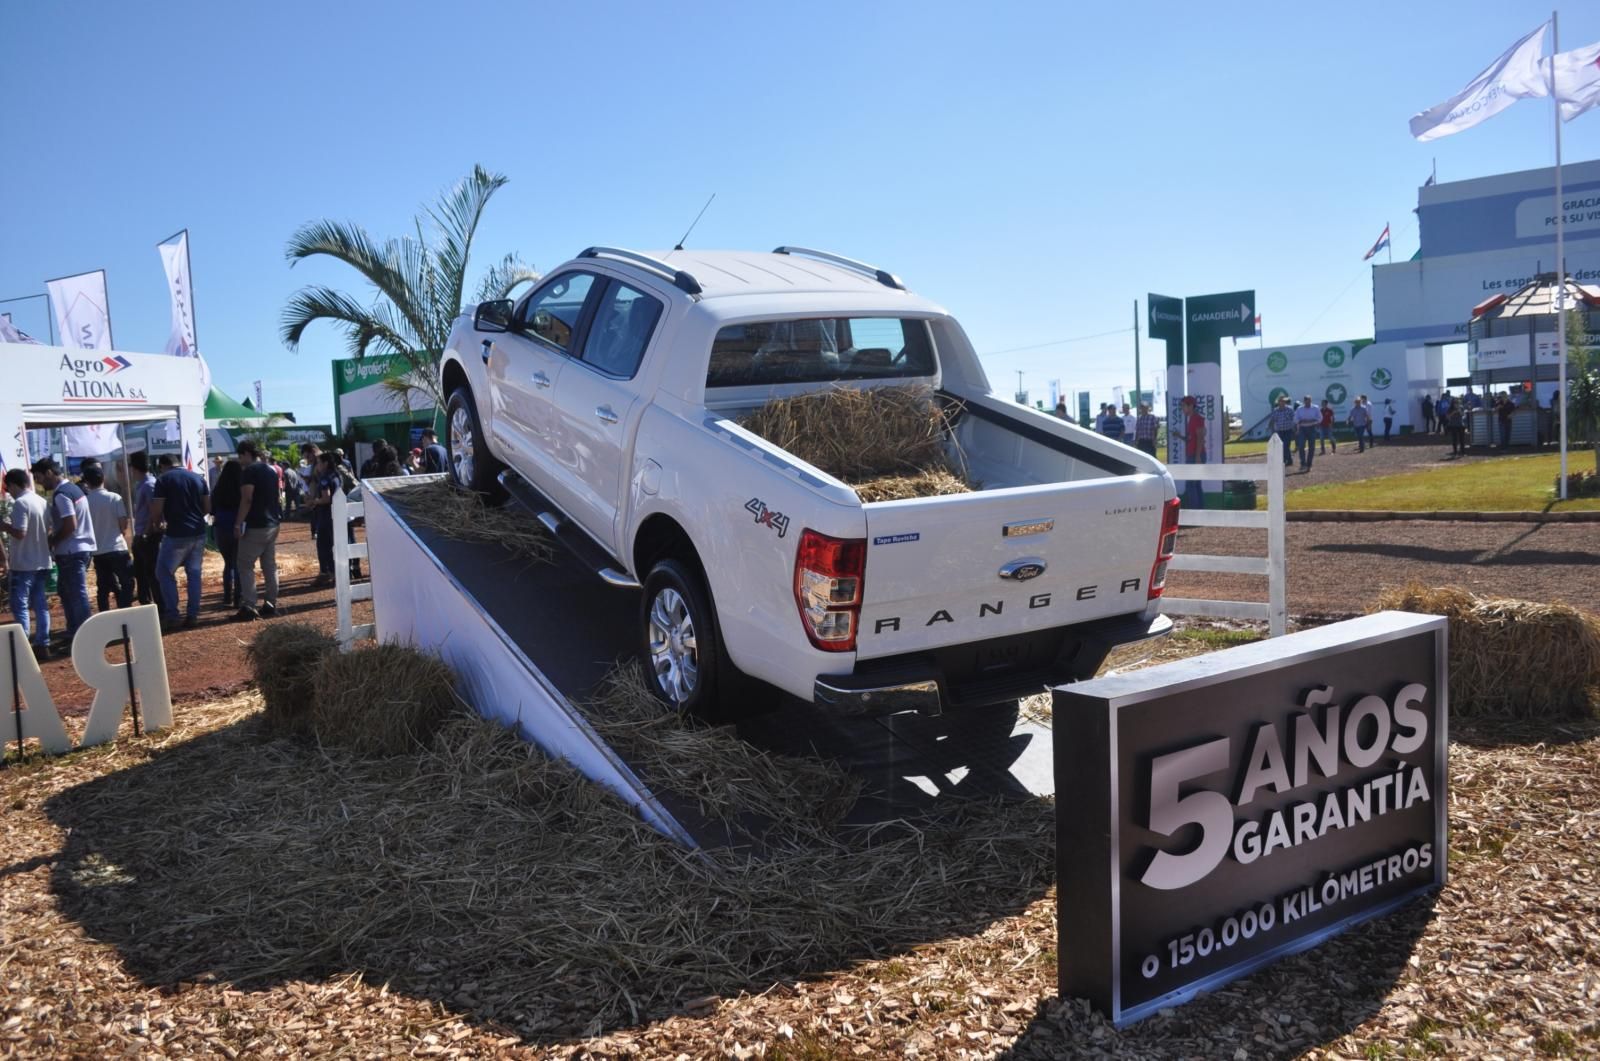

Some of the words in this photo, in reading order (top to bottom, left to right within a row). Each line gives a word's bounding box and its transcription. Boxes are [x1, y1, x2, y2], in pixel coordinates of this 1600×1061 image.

[1570, 213, 1584, 223] SU
[1482, 279, 1502, 290] Les
[1191, 308, 1240, 322] GANADERÍA
[59, 353, 105, 378] Agro
[62, 379, 126, 398] ALTONA
[129, 387, 148, 399] S.A.
[744, 497, 790, 539] 4x4
[1017, 565, 1040, 579] Ford
[874, 578, 1142, 634] RANGER
[1140, 736, 1234, 890] 5
[1237, 682, 1428, 807] AÑOS
[1233, 760, 1431, 866] GARANTÍA
[1167, 902, 1276, 969] 150.000
[1282, 842, 1433, 924] KILÓMETROS
